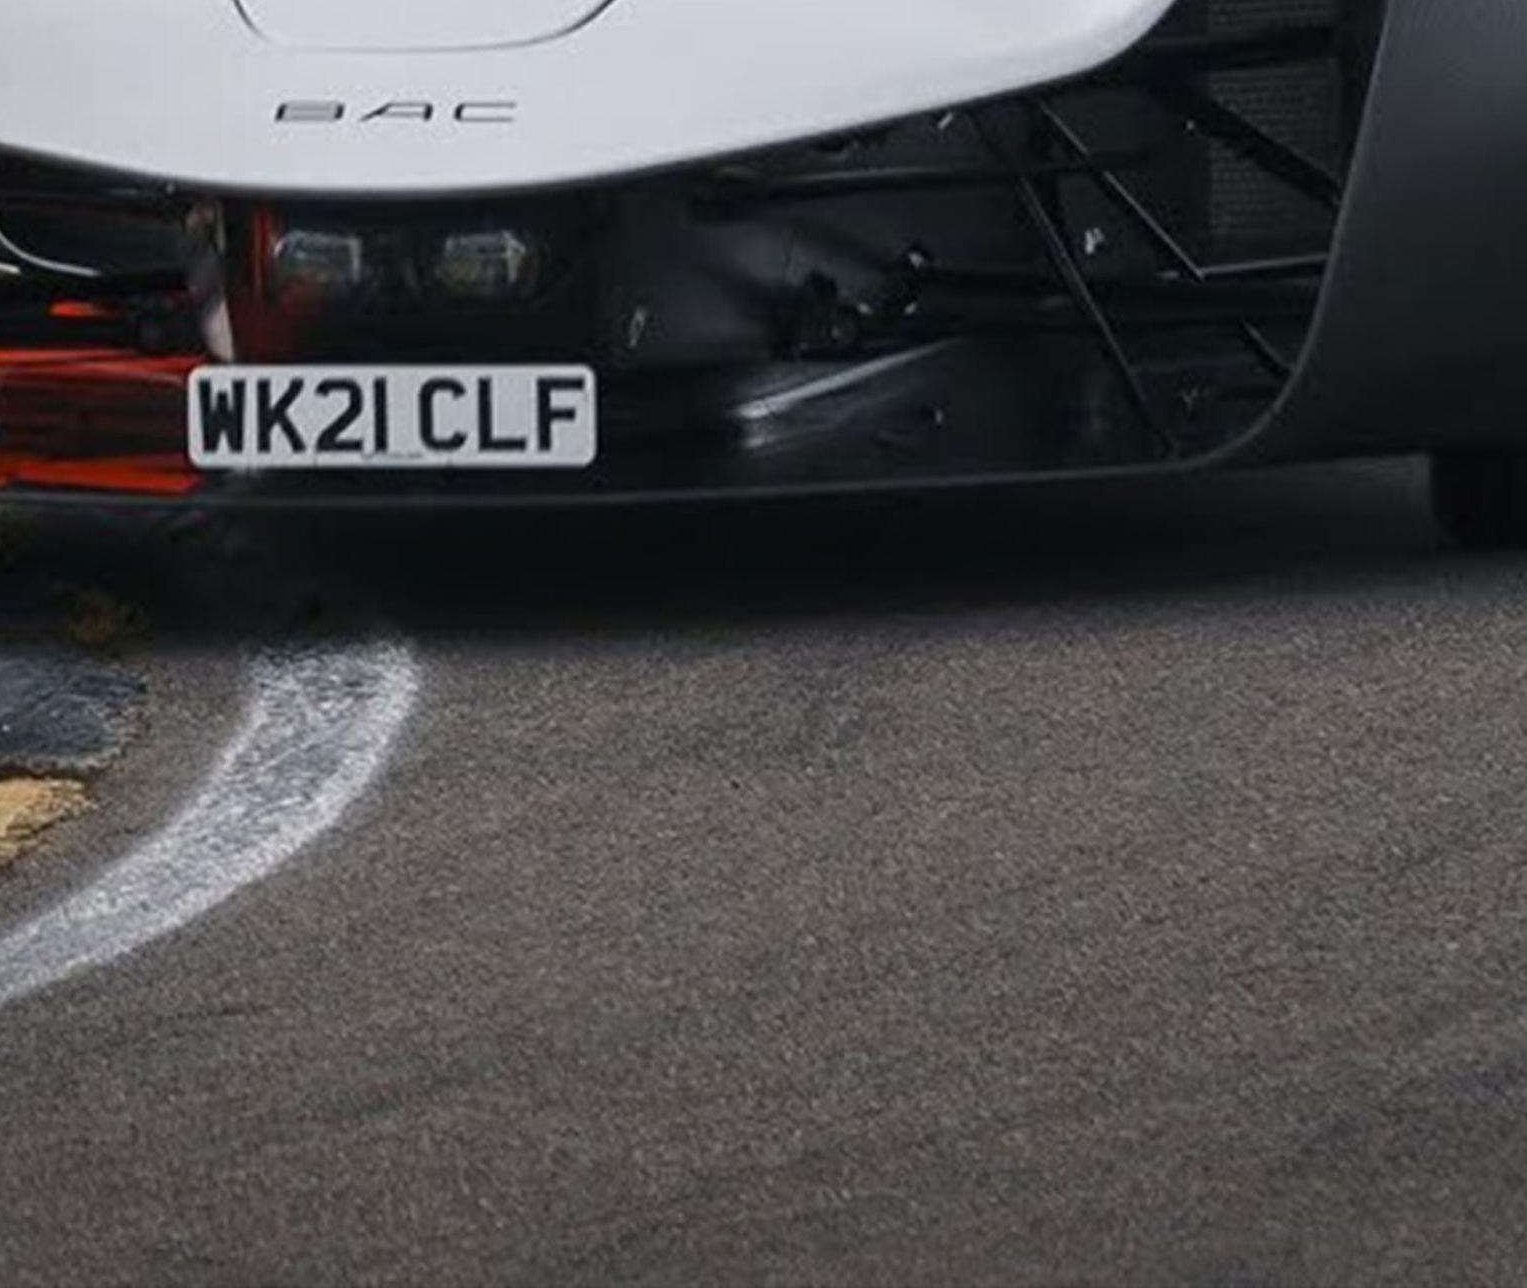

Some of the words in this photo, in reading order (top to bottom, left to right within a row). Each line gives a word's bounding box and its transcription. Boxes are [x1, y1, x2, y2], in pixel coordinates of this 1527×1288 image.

[274, 101, 517, 123] BAC
[198, 376, 388, 455] WK21
[417, 376, 586, 454] CLF
